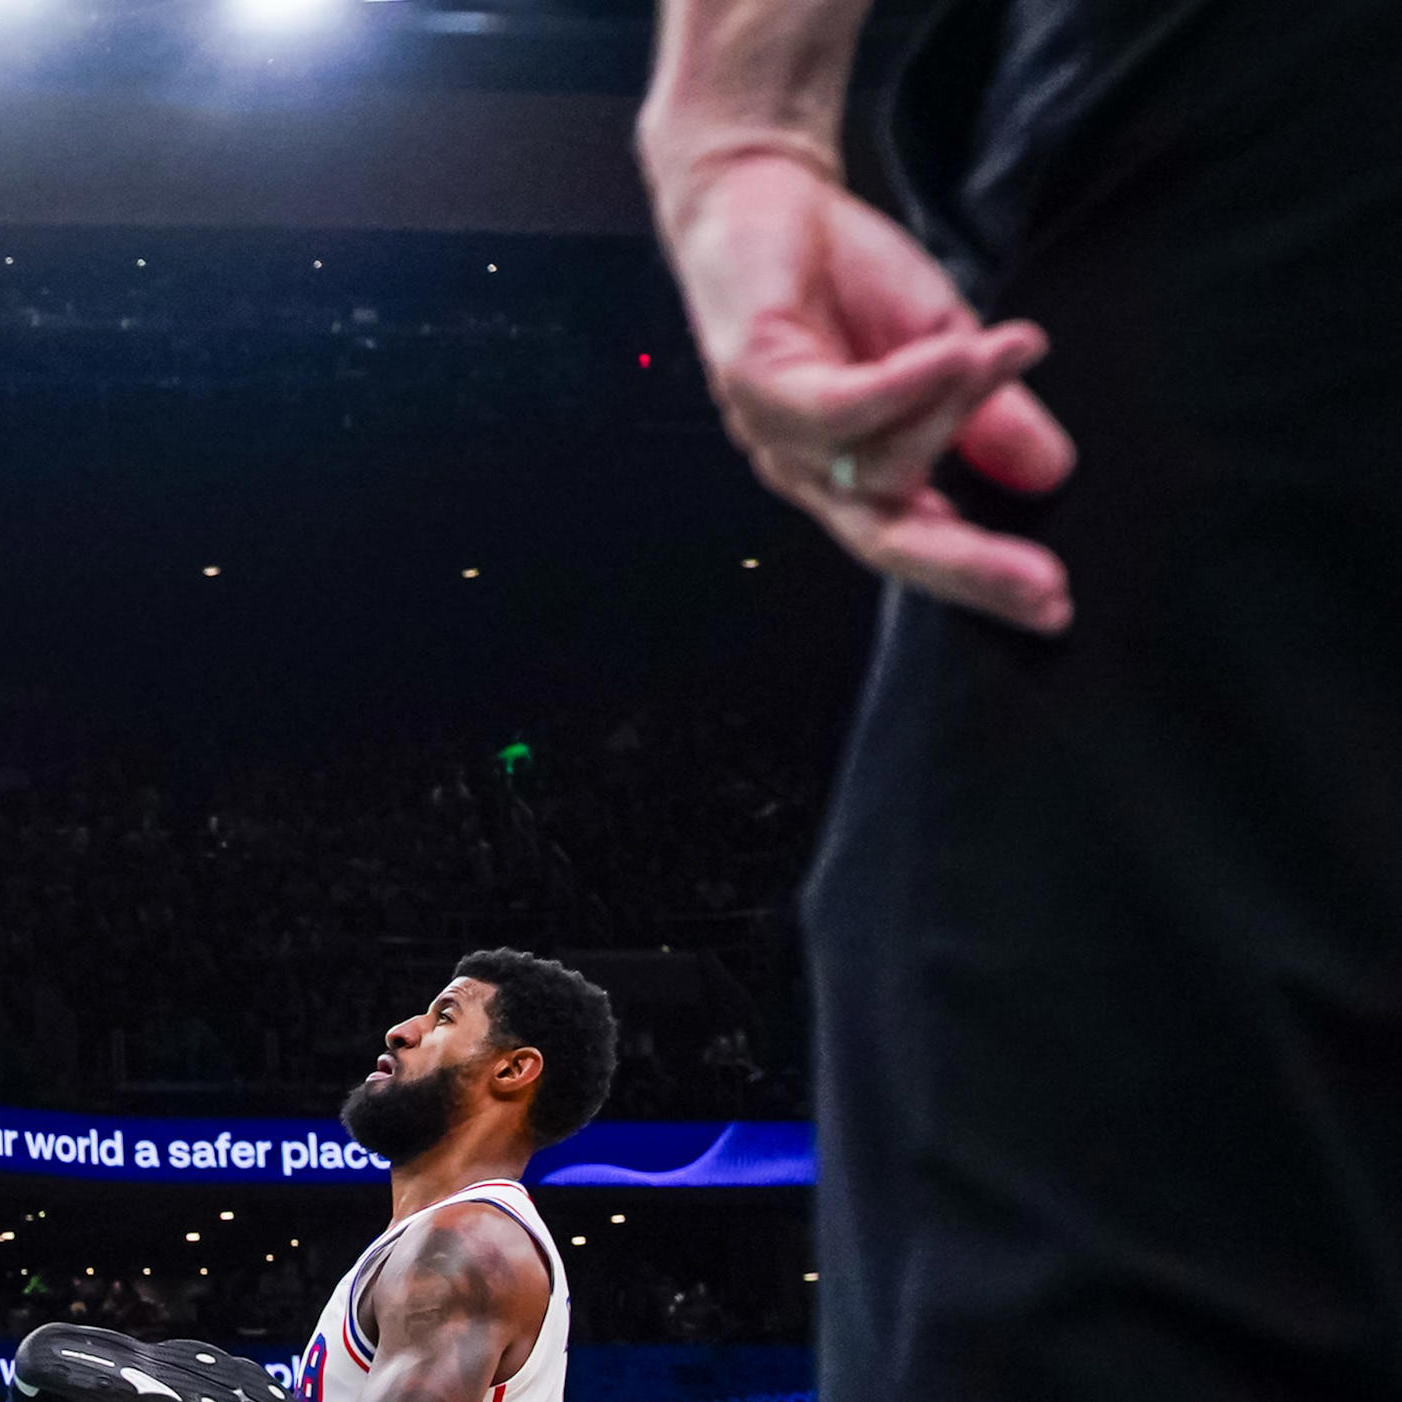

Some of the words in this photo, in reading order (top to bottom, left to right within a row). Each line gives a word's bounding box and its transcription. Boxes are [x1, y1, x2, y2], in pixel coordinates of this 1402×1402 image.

[24, 1128, 125, 1168] world
[134, 1140, 160, 1169] a
[168, 1131, 273, 1169] safer
